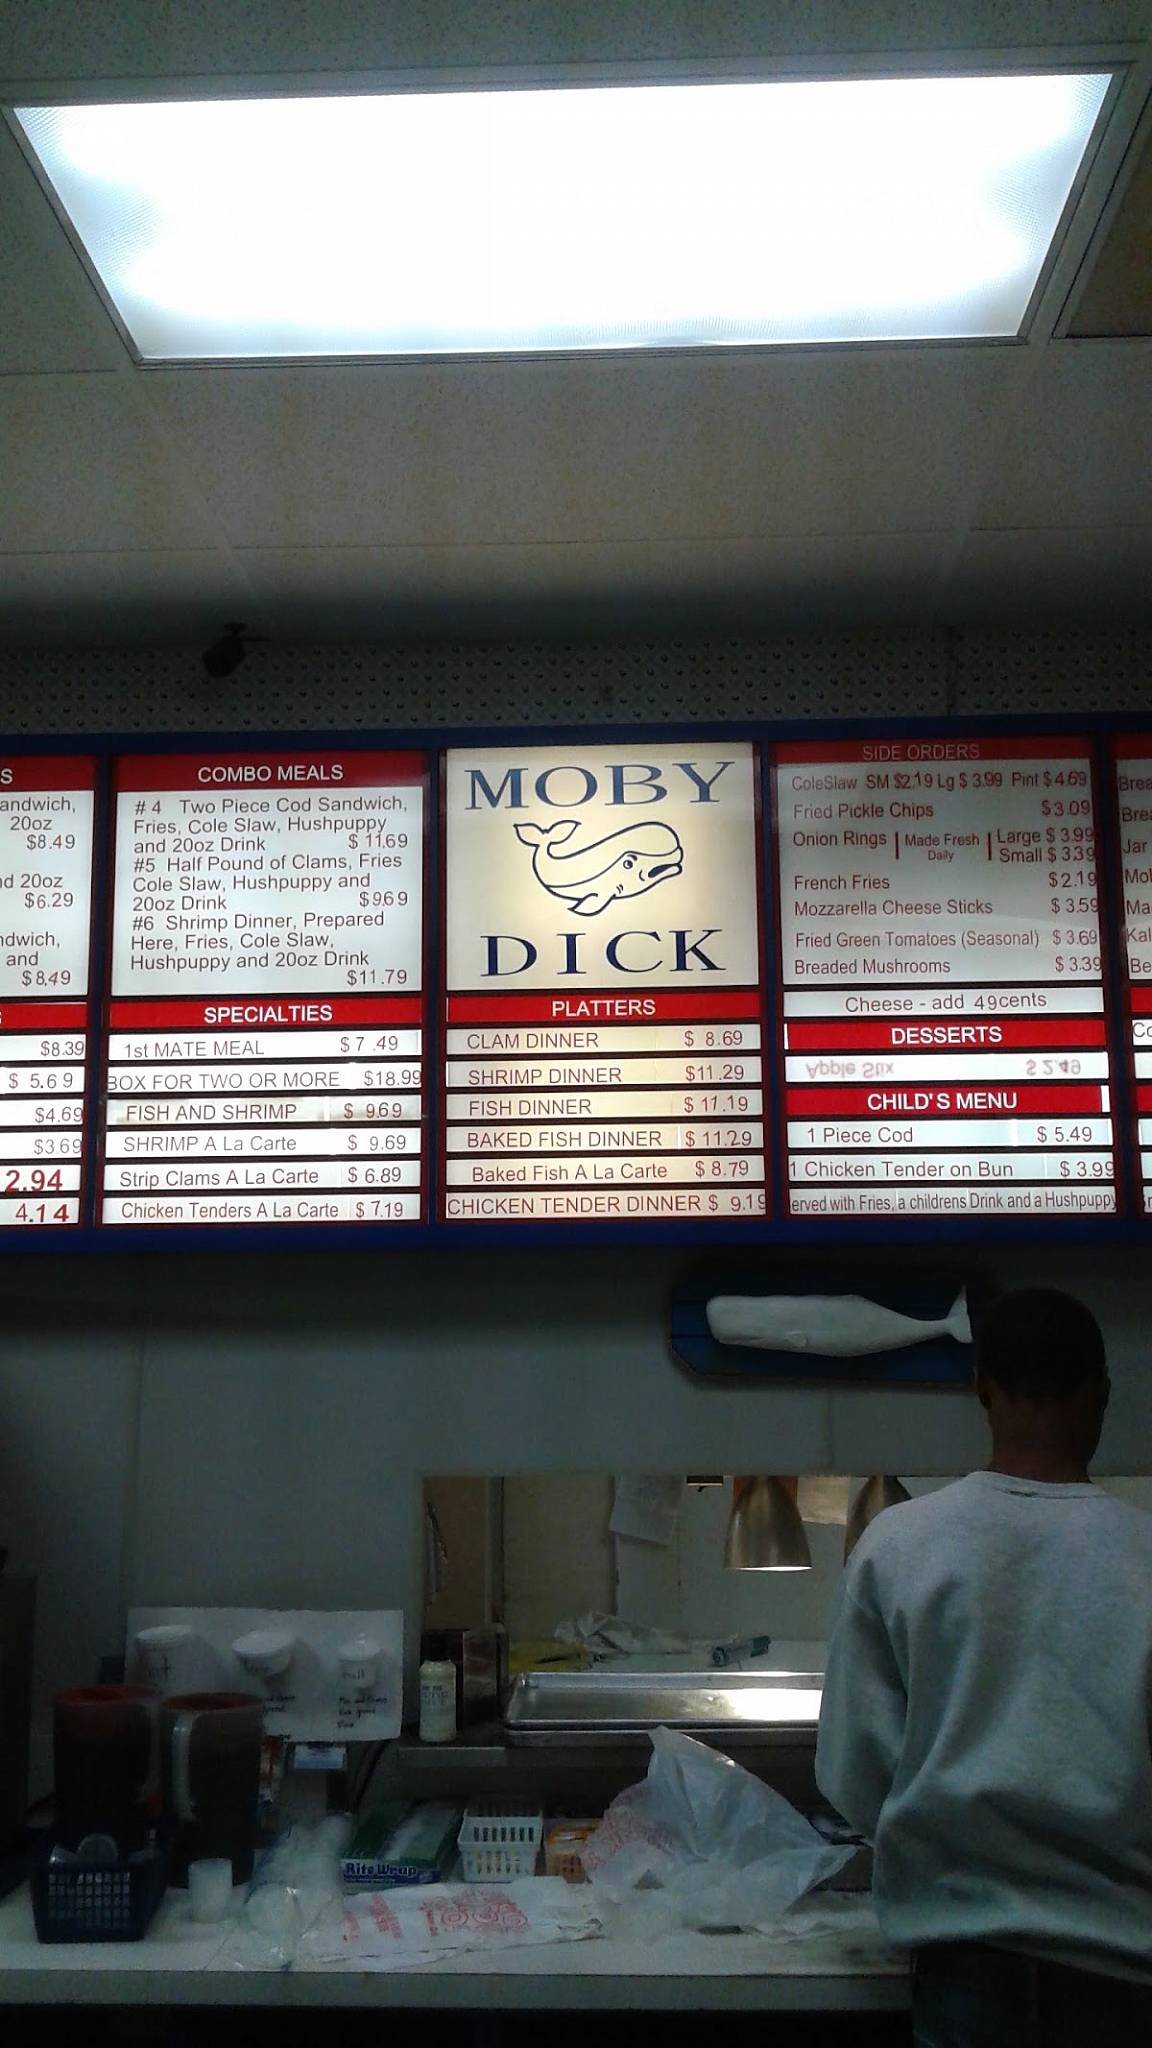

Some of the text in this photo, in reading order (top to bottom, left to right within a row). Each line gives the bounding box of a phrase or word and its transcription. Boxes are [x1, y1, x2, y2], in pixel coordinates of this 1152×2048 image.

[863, 744, 980, 761] SIDE ORDERS
[198, 764, 343, 783] COMBO MEALS
[866, 774, 889, 790] SM
[937, 773, 955, 792] Lg
[1012, 771, 1038, 787] Pint
[464, 761, 735, 810] MOBY
[179, 795, 407, 814] Two Piece Cod Sandwich,
[794, 801, 934, 821] Fried Pickle Chips
[10, 815, 52, 831] 20oz
[134, 816, 387, 836] Fries, Cole Slaw, Hushpuppy
[26, 834, 75, 851] $8.49
[134, 836, 266, 854] and 20oz Drink
[793, 830, 887, 849] Onion Rings
[905, 833, 980, 847] Made Fresh
[997, 828, 1041, 847] Large
[167, 857, 205, 872] Half
[208, 855, 263, 871] Pound
[270, 854, 287, 870] of
[292, 854, 352, 870] Clams,
[359, 853, 402, 868] Fries
[927, 849, 954, 863] Daily
[999, 847, 1042, 863] Small
[20, 873, 63, 889] 20oz
[133, 872, 370, 893] Cole Slaw, Hushpuppy and
[794, 874, 847, 890] French
[852, 874, 890, 889] Fries
[24, 892, 74, 909] $6.29
[133, 895, 227, 912] 20oz Drink
[795, 899, 993, 916] Mozzarella Cheese Sticks
[166, 914, 228, 933] Shrimp
[234, 914, 296, 930] Dinner,
[304, 910, 384, 931] Prepared
[131, 932, 334, 952] Here, Fries, Cole Slaw,
[796, 929, 1040, 948] Fried Green Tomatoes (Seasonal)
[6, 951, 39, 966] and
[131, 950, 369, 973] Hushpuppy and 20oz Drink
[480, 929, 727, 977] DICK
[795, 958, 951, 975] Breaded Mushrooms
[347, 969, 407, 986] $11.79
[552, 999, 656, 1017] PLATTERS
[845, 996, 913, 1013] Cheese
[932, 993, 964, 1010] add
[204, 1005, 332, 1024] SPECIALTIES
[467, 1032, 599, 1050] CLAM DINNER
[891, 1026, 1002, 1044] DESSERTS
[125, 1040, 265, 1058] 1st MATE MEAL
[153, 1074, 192, 1090] FOR
[199, 1073, 243, 1089] TWO
[249, 1072, 277, 1088] OR
[283, 1071, 340, 1088] MORE
[468, 1069, 542, 1086] SHRIMP
[549, 1067, 622, 1084] DINNER
[469, 1099, 592, 1116] FISH DINNER
[956, 1092, 1017, 1109] MENU
[126, 1103, 297, 1121] FISH AND SHRIMP
[123, 1135, 297, 1152] SHRIMP A La Carte
[467, 1130, 662, 1148] BAKED FISH DINNER
[807, 1126, 913, 1143] 1 Piece Cod
[472, 1163, 667, 1182] Baked Fish A La Carte
[790, 1161, 1013, 1177] 1 Chicken Tender on Bun
[5, 1168, 63, 1192] 2.94
[120, 1168, 319, 1190] Strip Clams A La Carte
[121, 1201, 339, 1218] Chicken Tenders A La Carte
[447, 1195, 701, 1215] CHICKEN TENDER DINNER
[829, 1195, 855, 1211] with
[859, 1194, 895, 1212] Fries,
[898, 1197, 906, 1210] a
[909, 1193, 967, 1210] childrens
[970, 1192, 1004, 1209] Drink
[1007, 1192, 1031, 1208] and
[1034, 1195, 1042, 1208] a
[15, 1203, 69, 1223] 4.14
